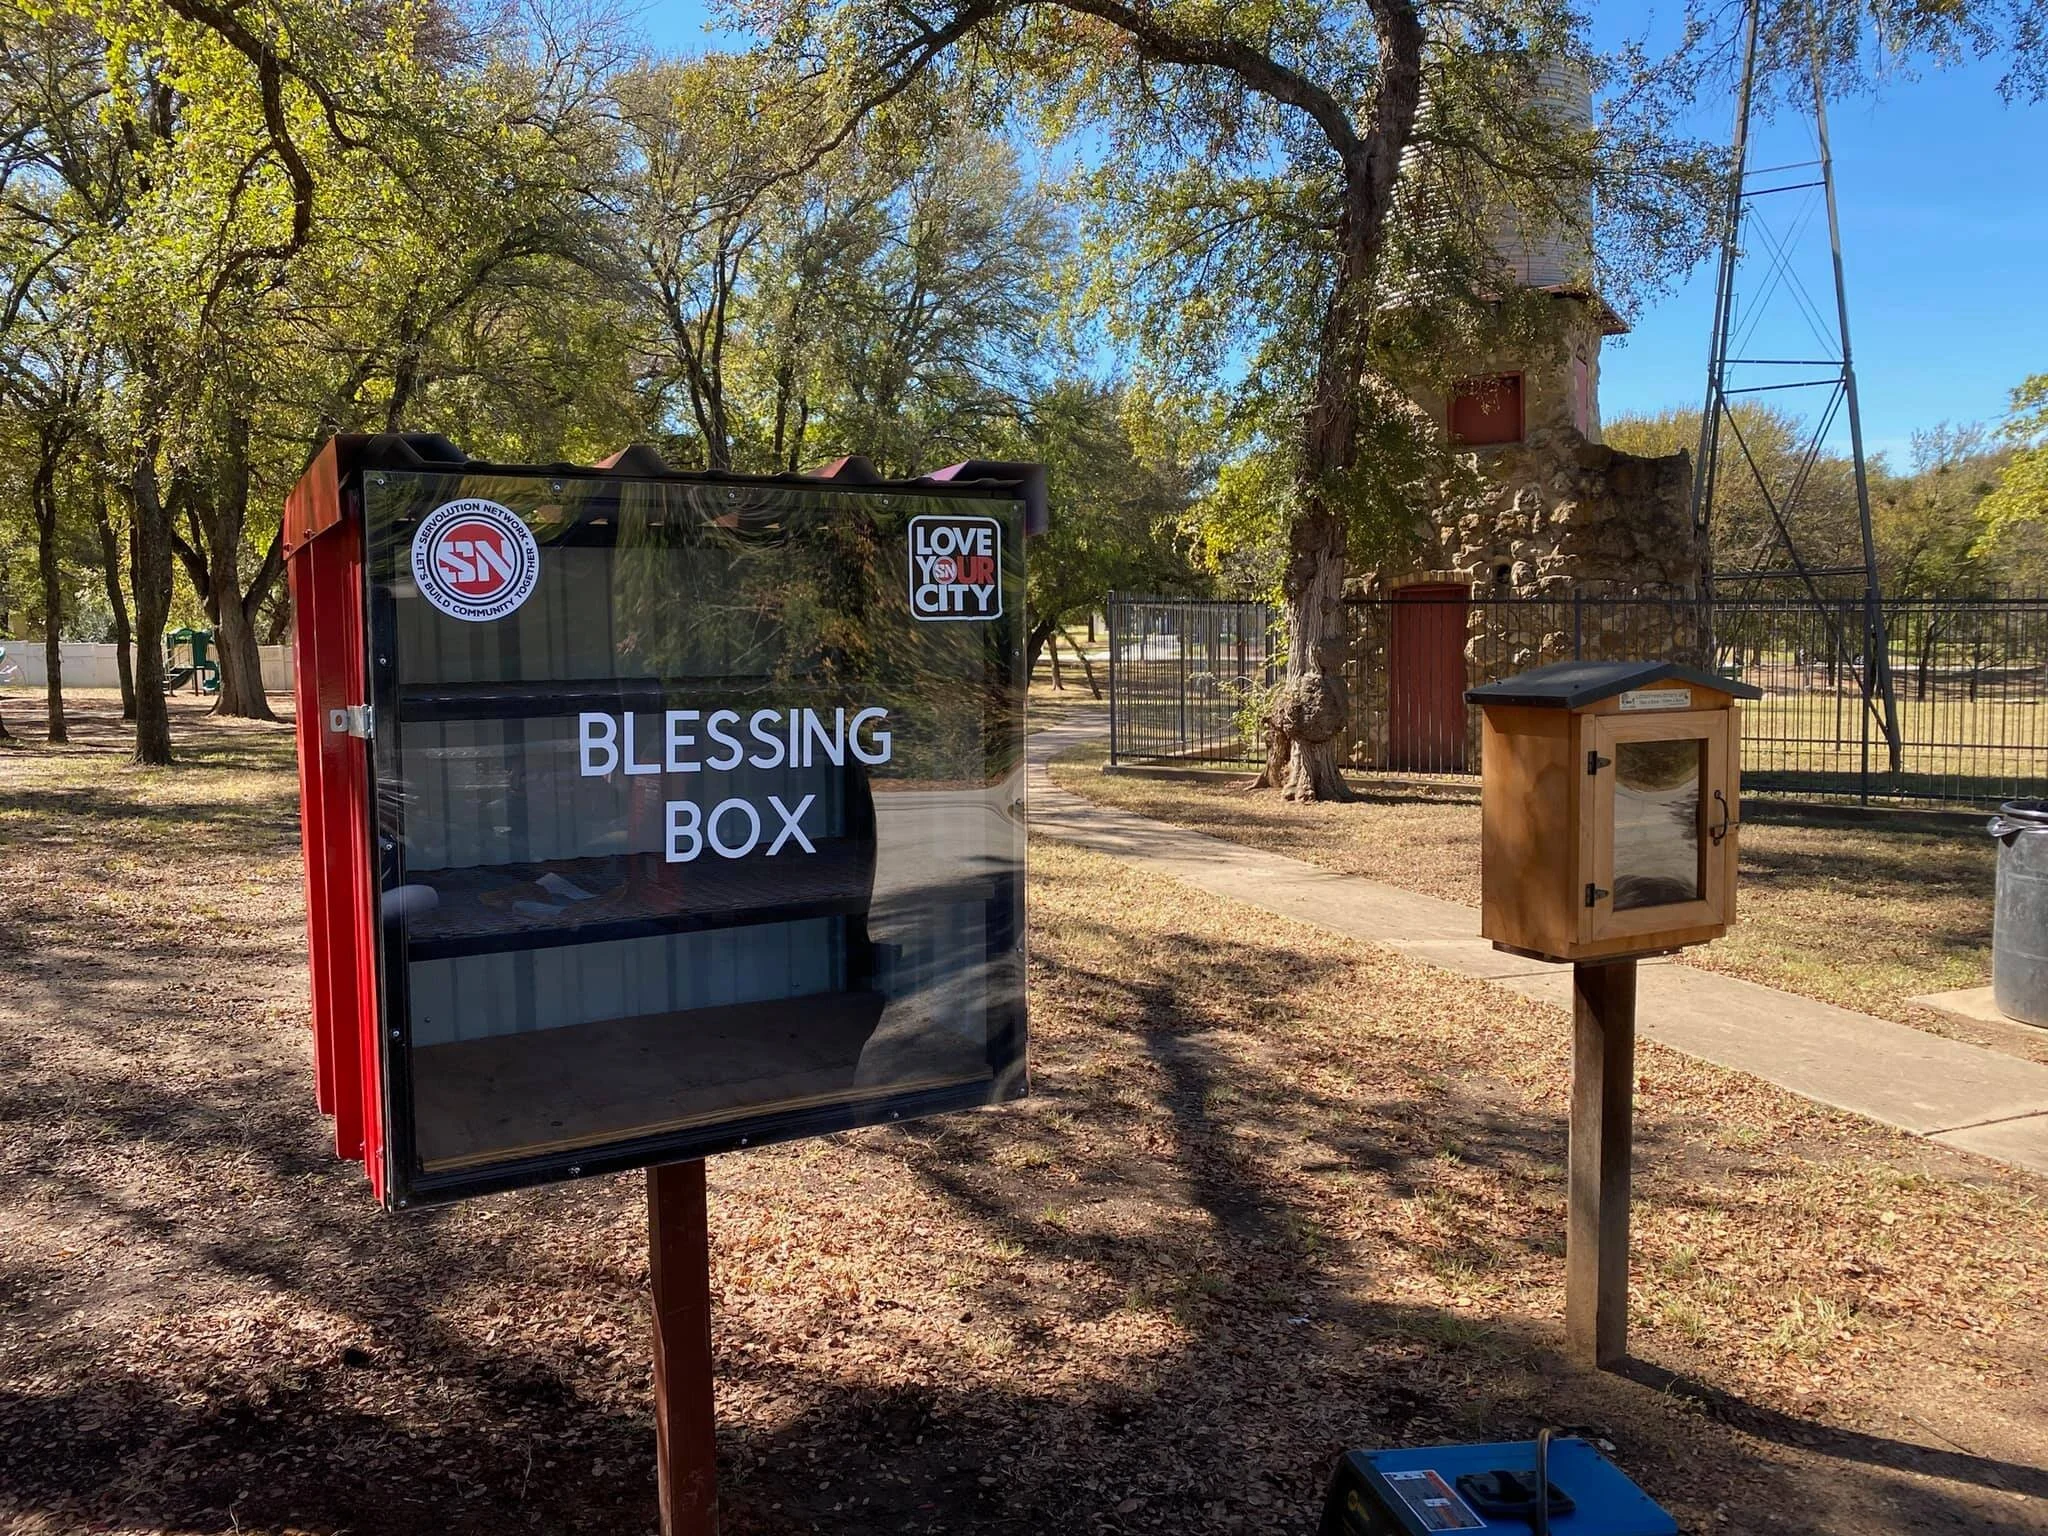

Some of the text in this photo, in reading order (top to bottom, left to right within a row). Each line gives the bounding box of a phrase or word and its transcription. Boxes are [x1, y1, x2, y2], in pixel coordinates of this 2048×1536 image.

[420, 503, 529, 545] SERVOLUTION NETWORK
[916, 526, 992, 556] LOVE
[416, 547, 536, 617] LET'S BUILD COMMUNITY TOGETHER
[437, 540, 514, 584] SN
[915, 584, 995, 612] CITY
[579, 707, 892, 777] BLESSING
[665, 794, 817, 864] BOX
